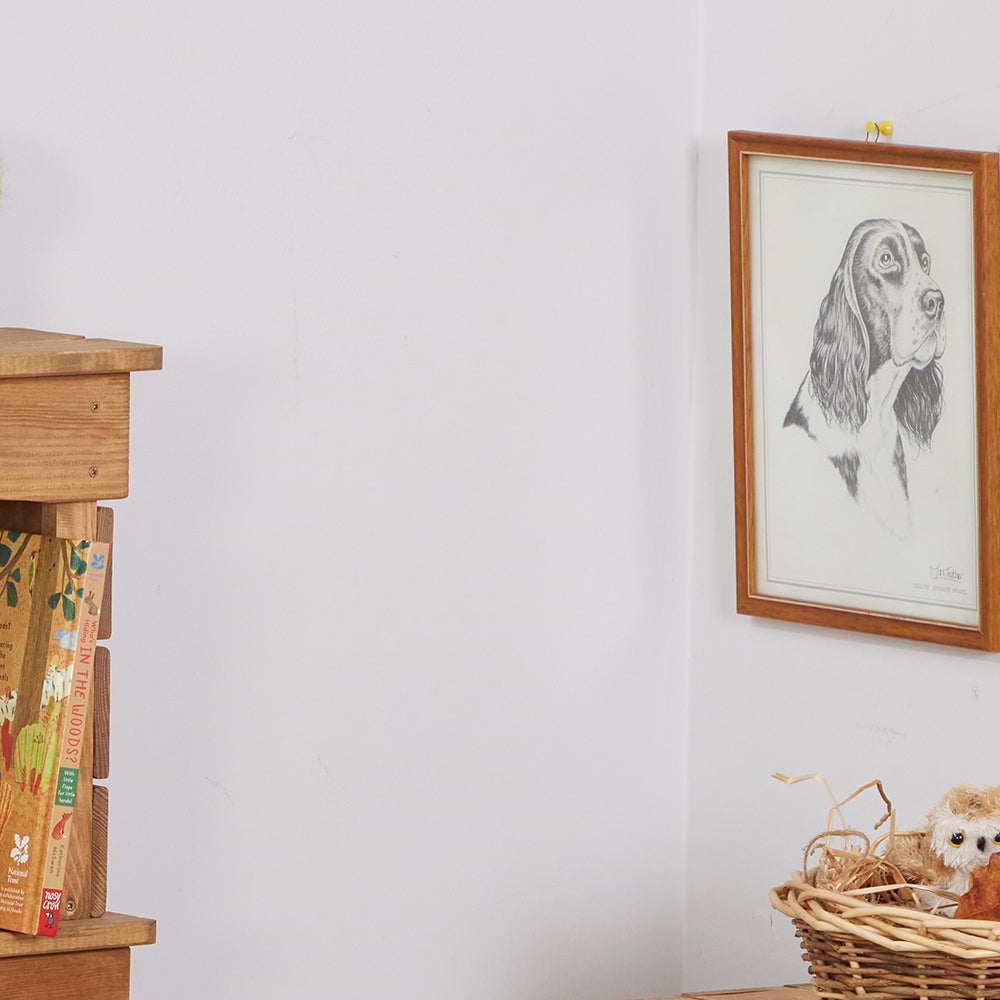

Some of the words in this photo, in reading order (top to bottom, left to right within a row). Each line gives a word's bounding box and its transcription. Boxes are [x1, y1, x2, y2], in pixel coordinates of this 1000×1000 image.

[80, 619, 90, 644] Hiding
[89, 620, 98, 643] Who's
[79, 645, 93, 665] IN
[74, 670, 90, 699] THE
[66, 703, 86, 764] WOODS?
